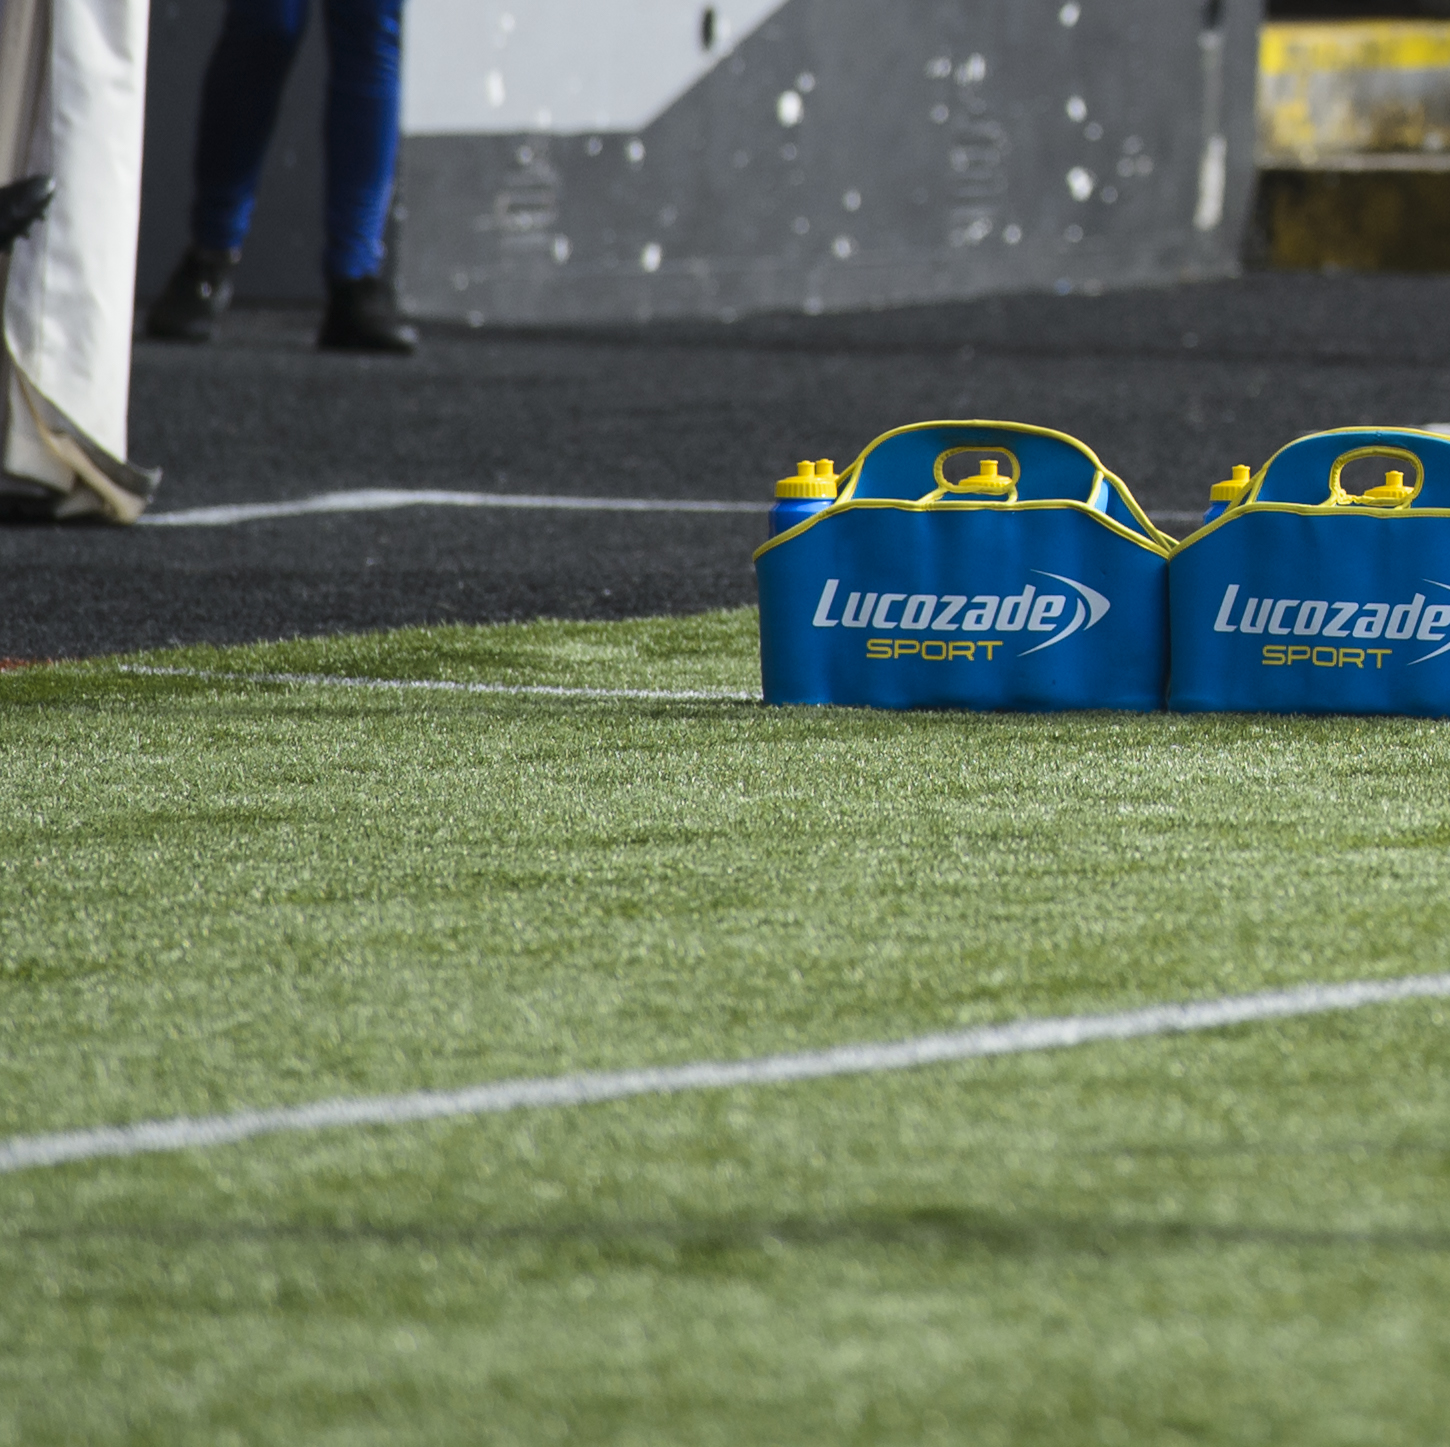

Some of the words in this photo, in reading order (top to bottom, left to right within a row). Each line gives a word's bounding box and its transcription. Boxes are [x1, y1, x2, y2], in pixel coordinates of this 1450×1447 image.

[812, 578, 1066, 632] Lucozade
[866, 638, 1003, 661] SPORT
[1261, 644, 1393, 669] SPORT
